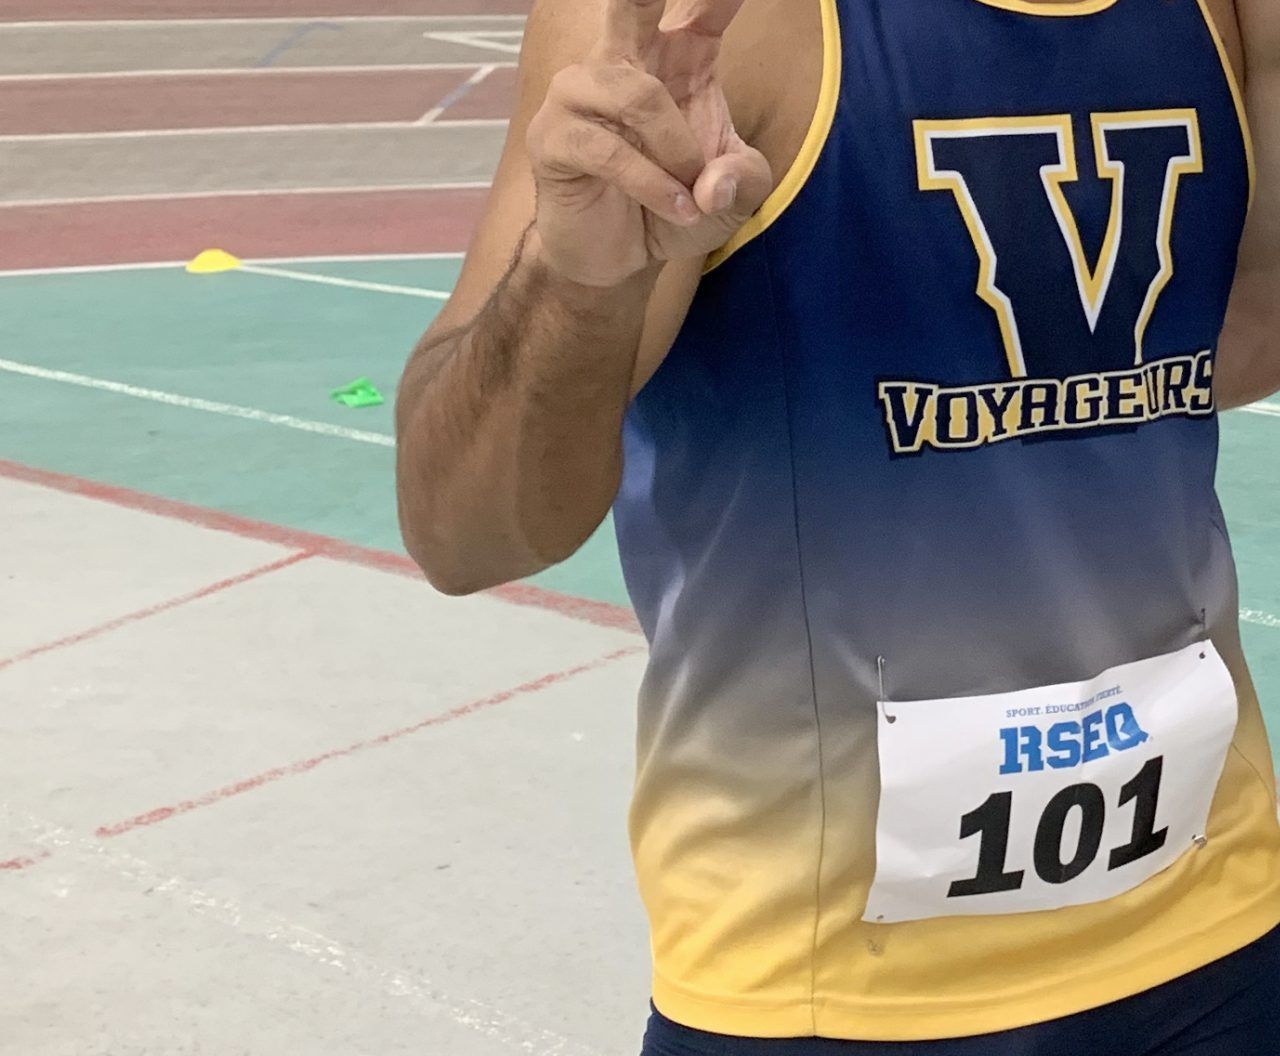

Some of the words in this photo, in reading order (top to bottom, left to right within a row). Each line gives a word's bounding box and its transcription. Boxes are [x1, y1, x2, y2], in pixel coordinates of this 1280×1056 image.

[912, 108, 1204, 378] V
[878, 349, 1214, 453] VOYAGEURS
[999, 701, 1150, 775] RSEQ
[946, 755, 1169, 898] 101
